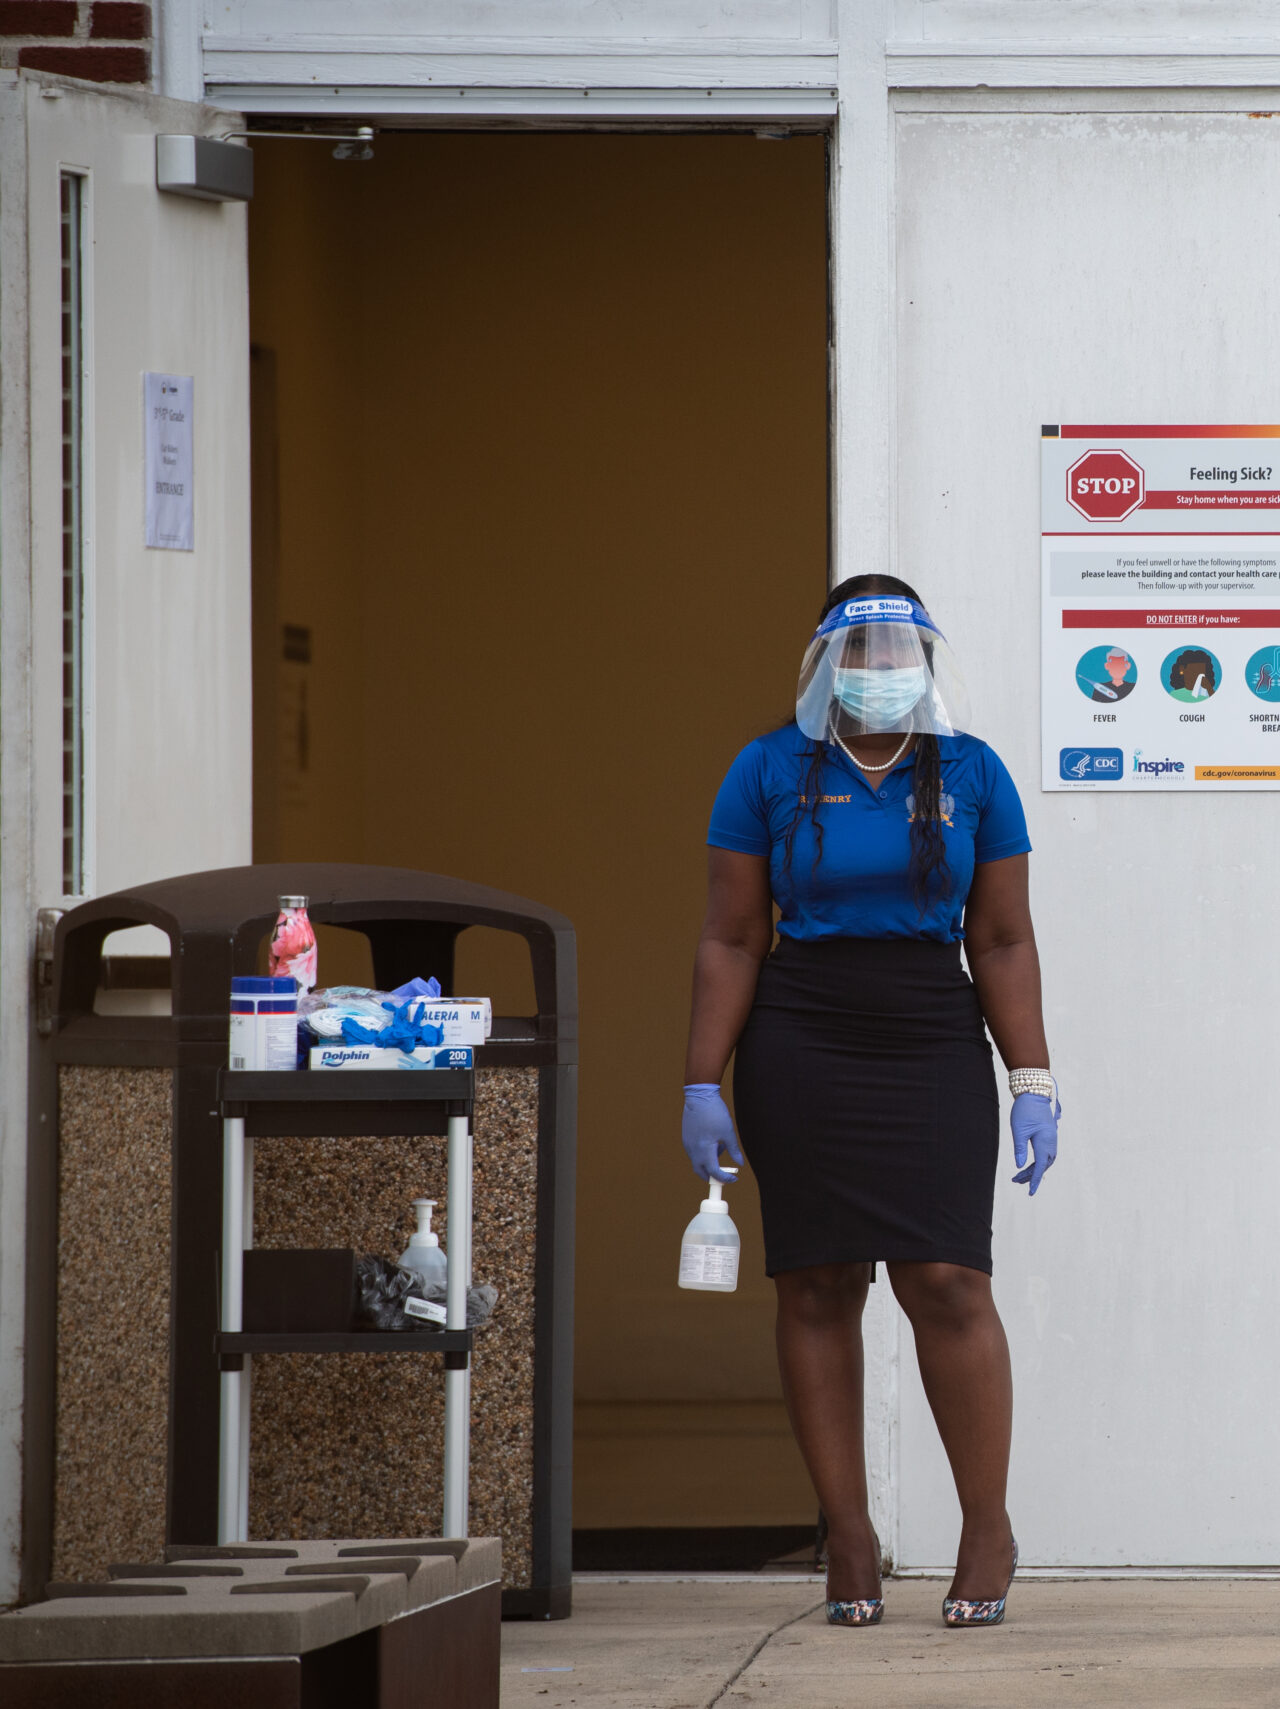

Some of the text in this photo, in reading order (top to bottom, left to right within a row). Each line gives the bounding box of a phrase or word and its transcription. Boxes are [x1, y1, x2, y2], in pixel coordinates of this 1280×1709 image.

[1190, 467, 1272, 483] Feeling Sick?
[155, 481, 184, 496] ENTRANCE
[1077, 478, 1135, 494] STOP
[1177, 495, 1193, 505] Stay
[1195, 495, 1215, 503] home
[1217, 495, 1238, 503] when
[1240, 497, 1253, 505] you
[1136, 558, 1148, 566] feel
[1182, 558, 1197, 566] have
[1211, 558, 1241, 568] following
[1082, 570, 1105, 579] please
[1142, 570, 1172, 579] building
[1155, 582, 1186, 591] follow-up
[849, 602, 909, 614] Face Shield
[1146, 615, 1240, 625] DO NOT ENTER if you have:
[1095, 759, 1117, 768] CDC
[1132, 751, 1185, 776] inspire
[1203, 770, 1276, 778] cdc.gov/coronavirus
[815, 794, 852, 803] ENRY
[421, 1010, 480, 1021] ALERIA M
[321, 1050, 370, 1061] Dolphin
[449, 1050, 467, 1061] 200
